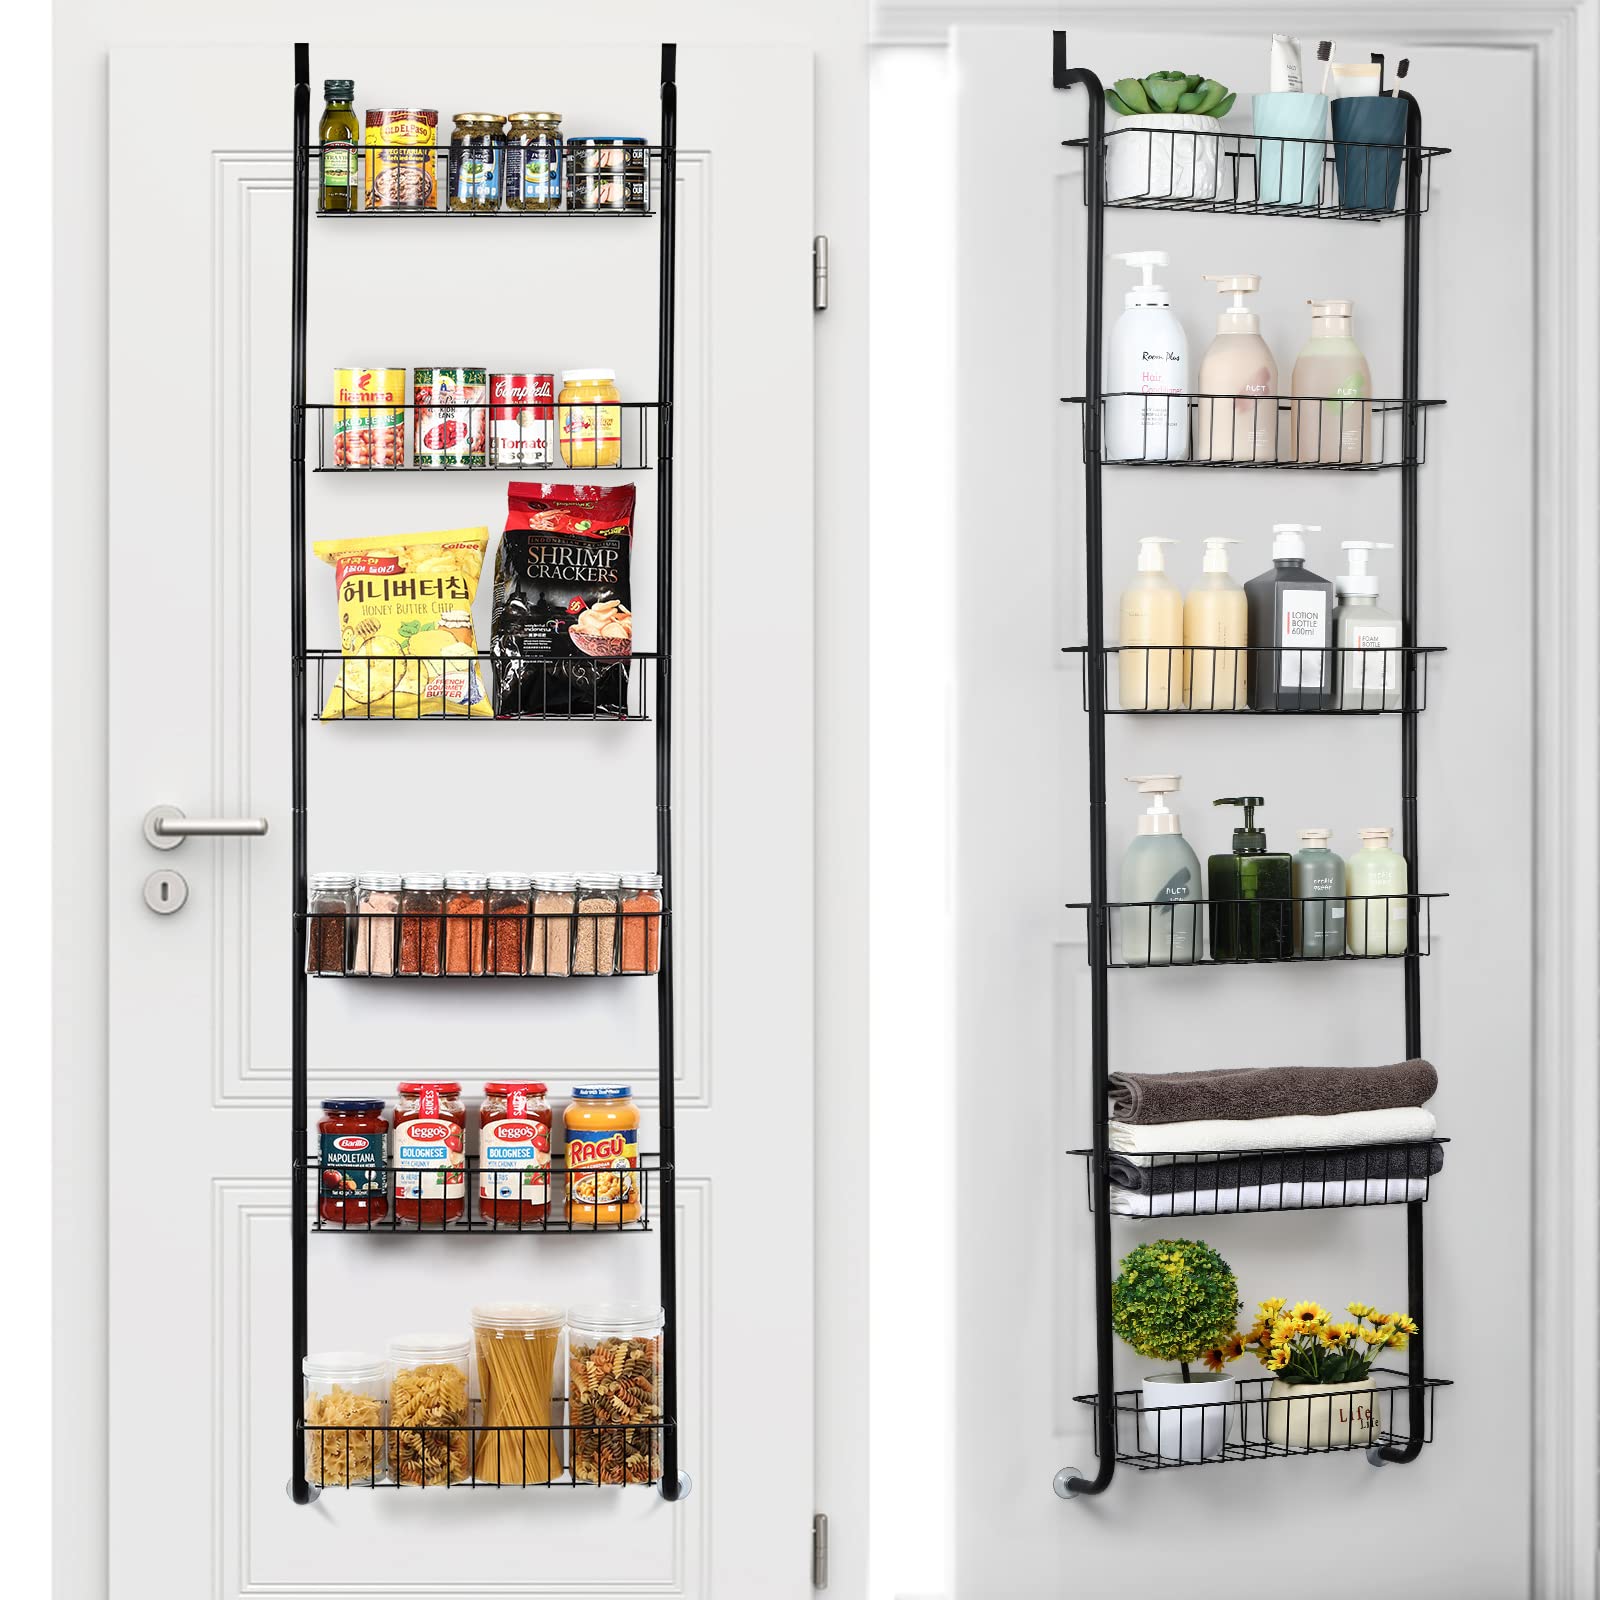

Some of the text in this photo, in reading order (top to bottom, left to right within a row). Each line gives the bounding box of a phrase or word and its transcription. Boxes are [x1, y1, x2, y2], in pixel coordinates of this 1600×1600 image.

[1142, 351, 1180, 362] Room Plus
[1142, 372, 1162, 382] Hair
[339, 388, 393, 402] fiamma
[495, 379, 552, 400] Campbell's
[365, 414, 396, 426] BENS
[501, 437, 548, 449] Tomato
[441, 543, 480, 551] Calbee
[530, 537, 580, 545] INDONESIAN
[527, 545, 619, 568] SHRIMP
[527, 564, 618, 583] CRACKERS
[343, 575, 469, 603] 허니버터칩
[362, 601, 454, 616] HONEY BUTTER CHIP
[1292, 612, 1319, 620] LOTION
[1291, 620, 1318, 628] BOTTLE
[1291, 627, 1315, 636] 600ml
[425, 1089, 434, 1116] SAUCES
[411, 1126, 448, 1139] Leggo's
[498, 1126, 534, 1138] Leggo's
[341, 1139, 367, 1148] Barilla
[402, 1148, 444, 1158] BOLOGNESE
[489, 1148, 531, 1158] BOLOGNESE
[571, 1135, 624, 1165] RAGÚ
[327, 1153, 375, 1163] NAPOLETANA
[1339, 1405, 1372, 1423] Life
[1360, 1417, 1379, 1429] Life
